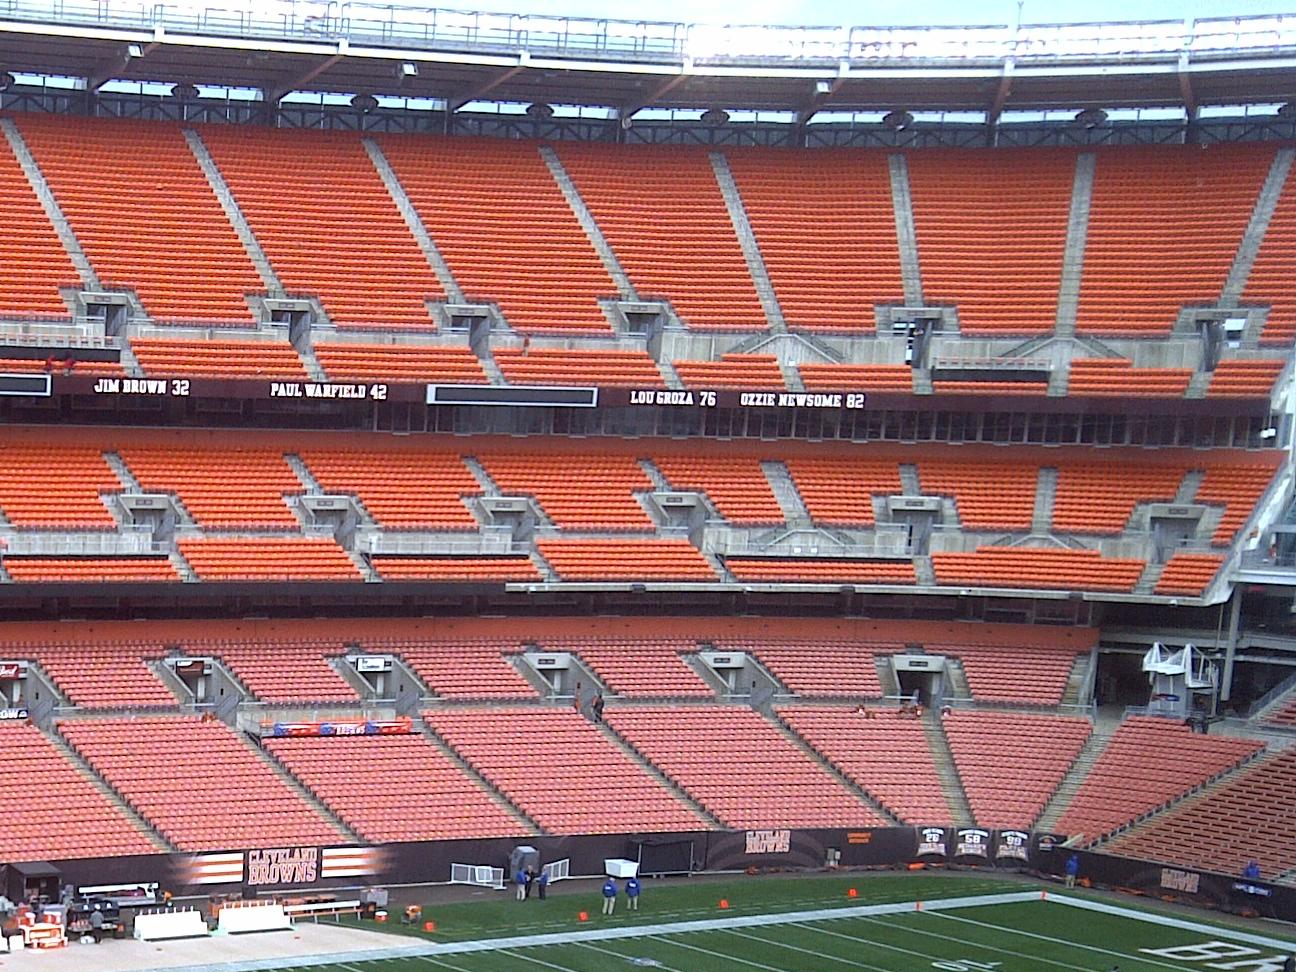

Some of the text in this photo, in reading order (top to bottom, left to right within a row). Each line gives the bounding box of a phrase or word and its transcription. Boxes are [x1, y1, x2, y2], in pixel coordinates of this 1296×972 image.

[94, 379, 190, 396] JIM BROWN 32
[270, 382, 387, 400] PAUL WARFIELD 42
[631, 390, 716, 407] LOU GROZA 76
[740, 392, 864, 408] OZZIE NEWSOME 82
[248, 847, 318, 864] CLEVELAND
[247, 861, 318, 885] BROWNS
